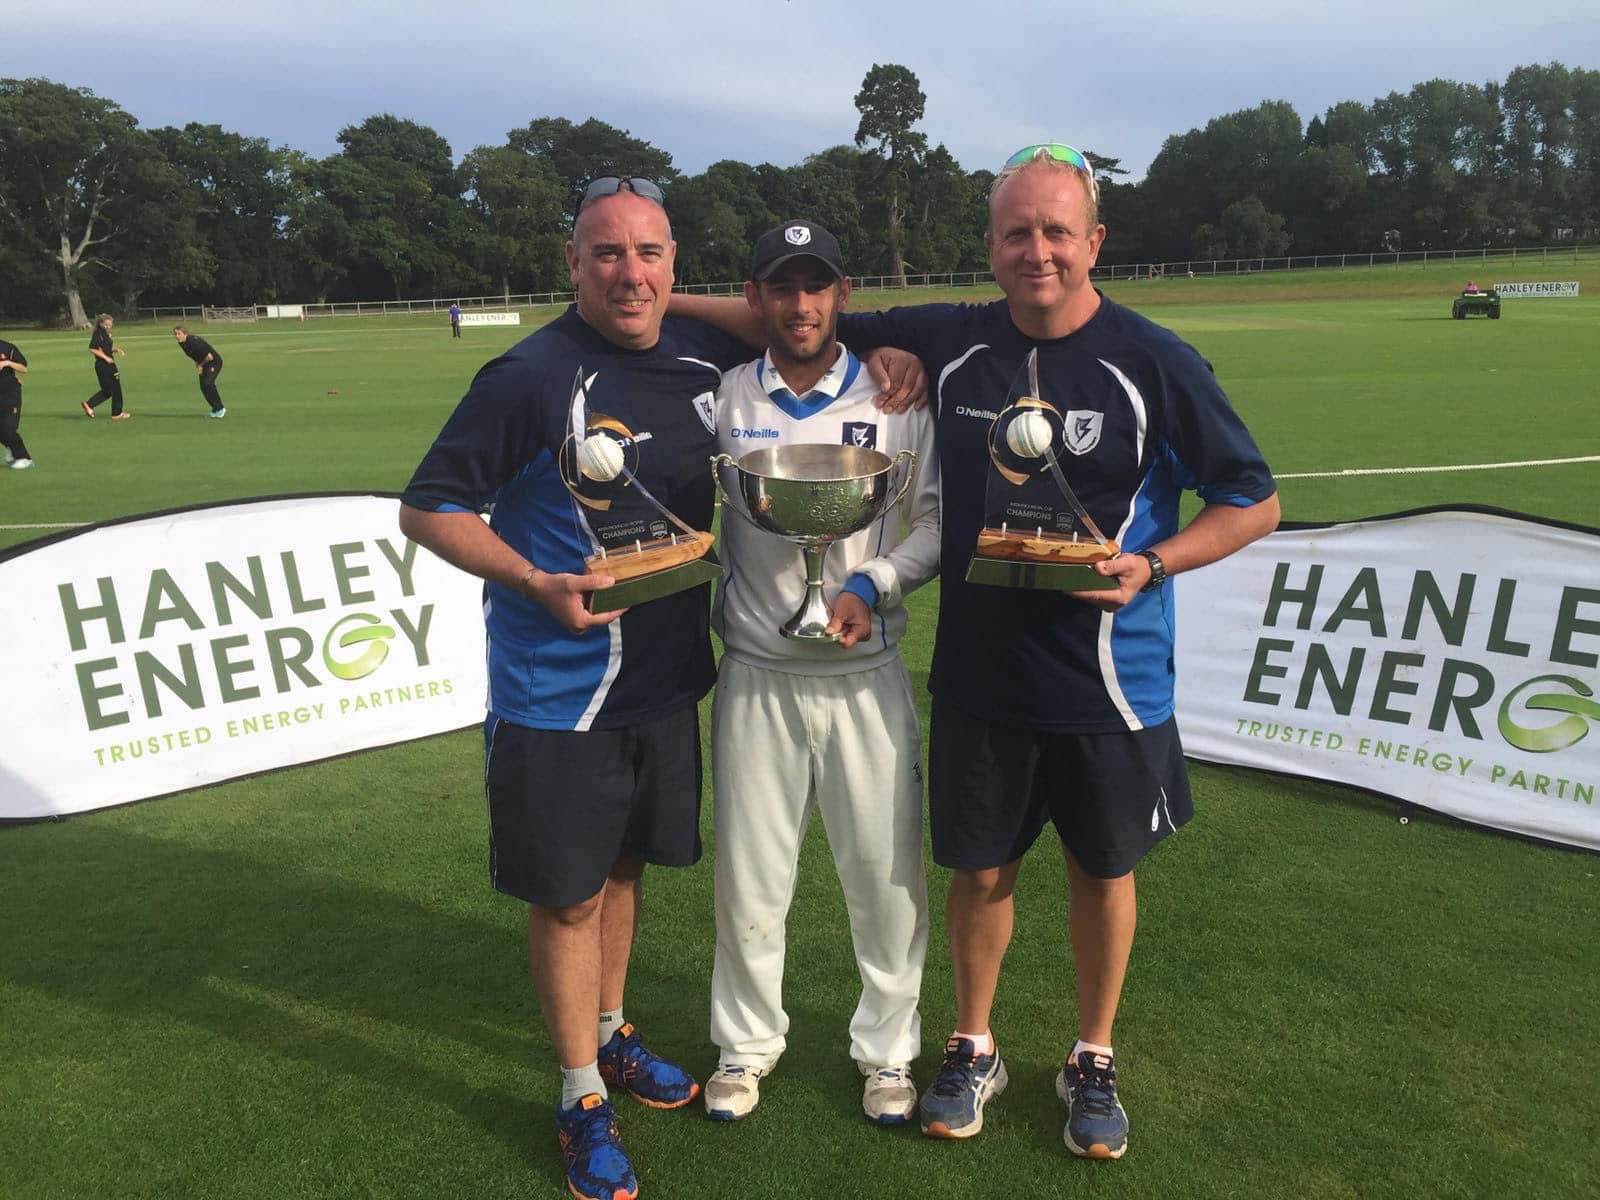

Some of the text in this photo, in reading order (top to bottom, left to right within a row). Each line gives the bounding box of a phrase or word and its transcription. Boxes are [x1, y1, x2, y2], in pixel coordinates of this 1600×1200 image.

[1495, 283, 1534, 293] HANLEY
[730, 428, 779, 438] O'Neills
[1006, 508, 1052, 521] CHAMPIONS
[57, 538, 419, 651] HANLEY
[75, 604, 435, 731] ENERGY
[94, 678, 454, 766] TRUSTED ENERGY PARTNERS
[1236, 718, 1344, 751] TRUSTED
[1358, 737, 1474, 776] ENERGY
